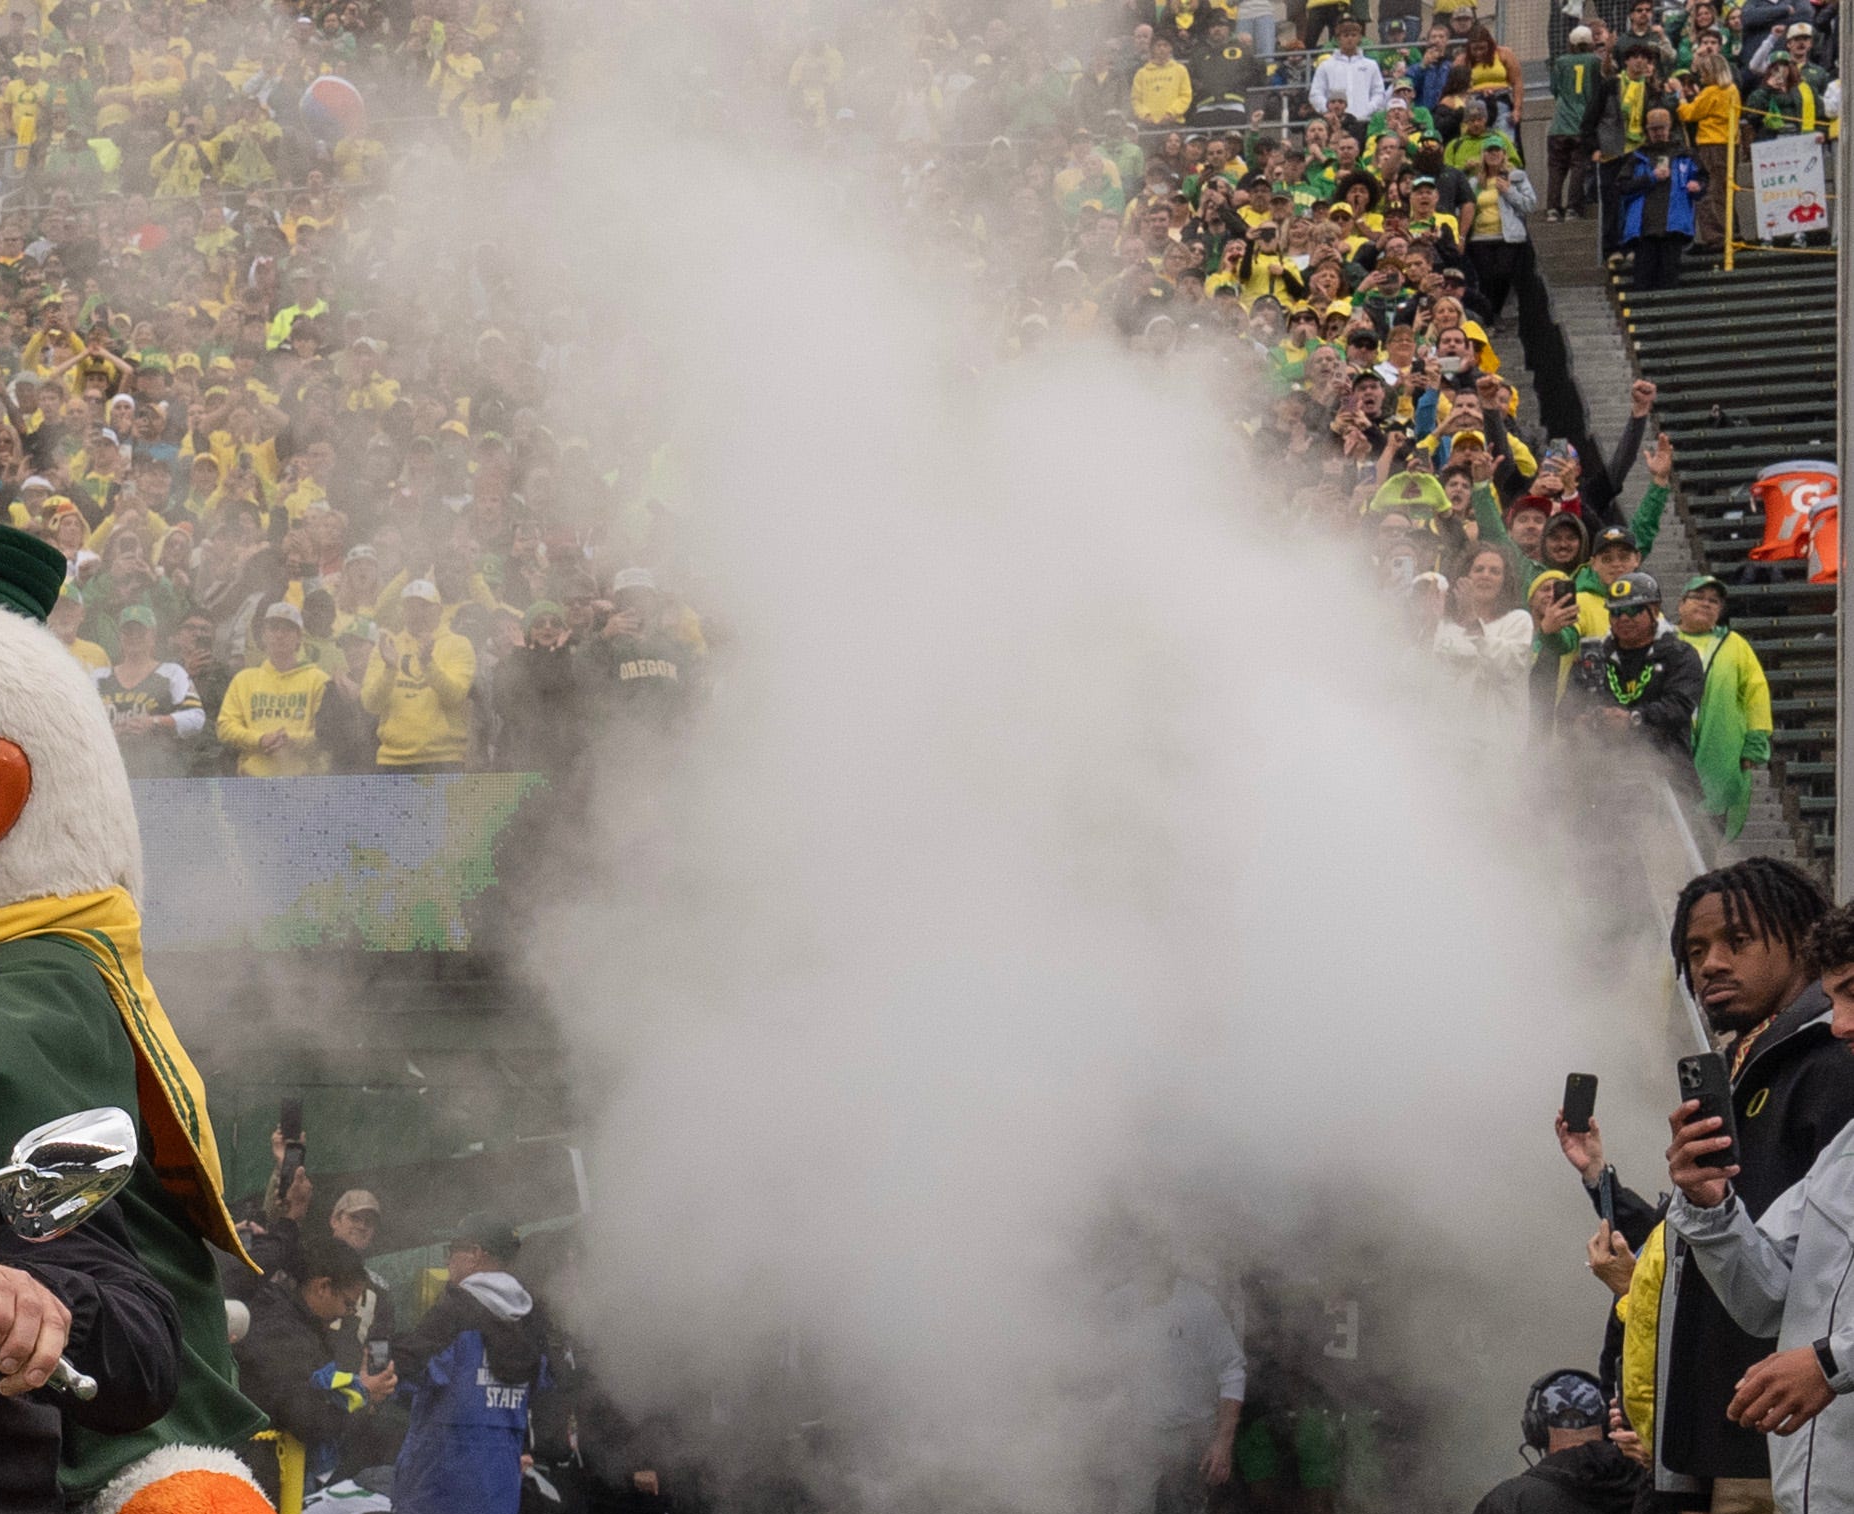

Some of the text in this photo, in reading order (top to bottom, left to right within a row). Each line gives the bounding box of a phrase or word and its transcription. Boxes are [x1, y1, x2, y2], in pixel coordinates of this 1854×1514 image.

[1573, 64, 1585, 95] 1
[1610, 580, 1632, 598] O
[620, 658, 678, 683] OREGON
[250, 692, 308, 710] OREGON
[485, 1386, 527, 1409] STAFF
